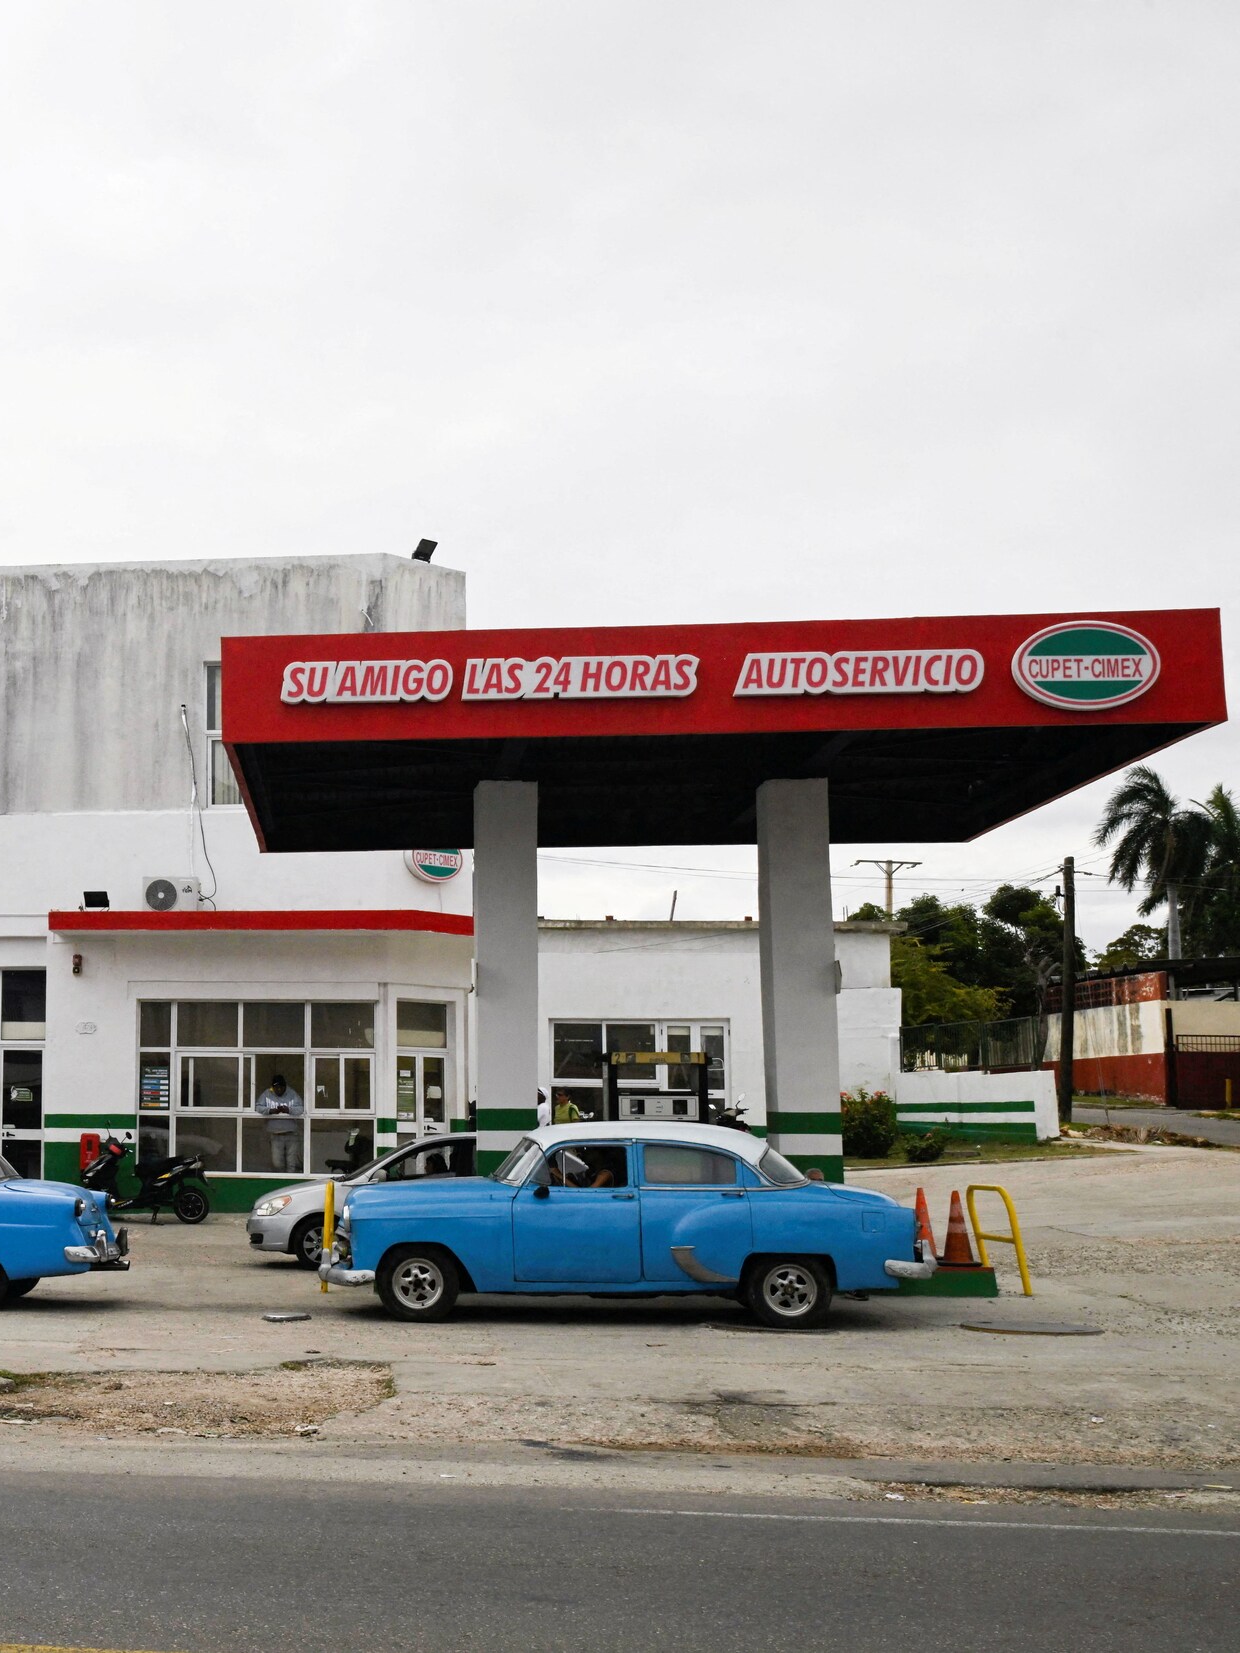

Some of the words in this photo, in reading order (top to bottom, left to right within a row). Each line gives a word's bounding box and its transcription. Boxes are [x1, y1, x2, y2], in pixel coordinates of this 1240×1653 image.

[287, 665, 330, 698] SU
[334, 662, 450, 697] AMIGO
[465, 662, 523, 696] LAS
[534, 661, 572, 694] 24
[579, 658, 694, 693] HORAS
[742, 653, 979, 690] AUTOSERVICIO
[1028, 656, 1145, 680] CUPET-CIMEX
[614, 1053, 621, 1063] 2
